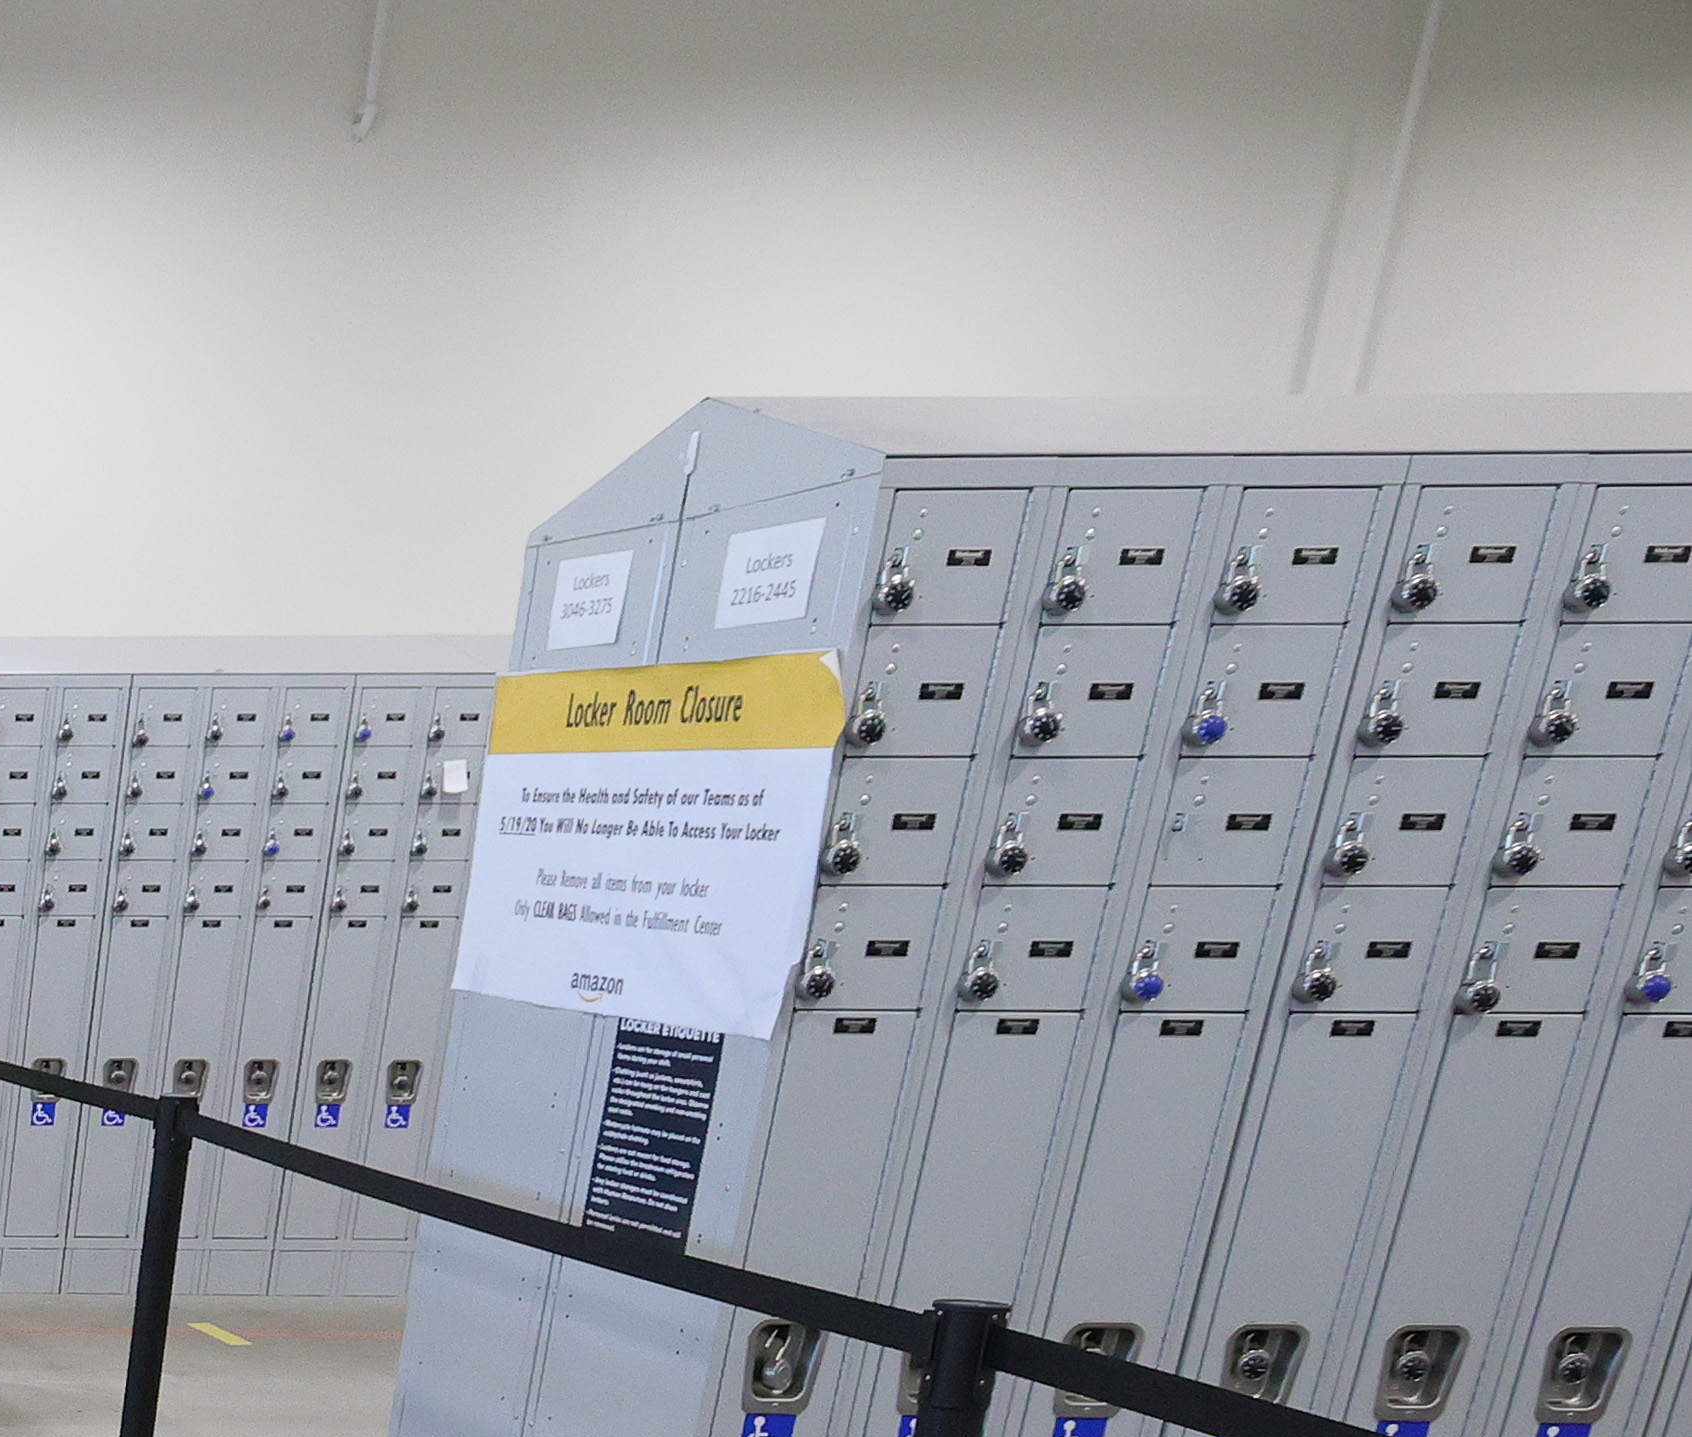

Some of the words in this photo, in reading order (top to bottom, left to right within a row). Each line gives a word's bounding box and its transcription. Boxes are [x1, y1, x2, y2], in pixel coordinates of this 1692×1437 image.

[746, 551, 794, 575] Lockers
[573, 573, 610, 591] Lockers
[730, 580, 797, 607] 2216-2445
[565, 691, 618, 728] Locker
[622, 689, 672, 726] Room
[680, 685, 743, 723] Closure
[522, 788, 531, 803] To
[532, 787, 560, 803] Ensure
[563, 788, 575, 803] the
[578, 788, 609, 804] Health
[612, 788, 631, 804] and
[632, 788, 664, 809] Safety
[666, 788, 679, 805] of
[680, 793, 700, 806] our
[703, 789, 736, 806] Teams
[737, 794, 750, 806] as
[752, 788, 766, 807] of
[498, 816, 537, 834] 5/19/20
[539, 817, 554, 833] You
[556, 818, 574, 833] Will
[575, 818, 589, 834] No
[591, 819, 623, 839] Longer
[626, 820, 639, 836] Be
[641, 820, 665, 837] Able
[668, 821, 678, 837] To
[680, 821, 717, 839] Access
[720, 822, 743, 840] Your
[744, 823, 781, 841] Locker
[655, 882, 678, 900] your
[680, 878, 710, 897] locker
[694, 915, 723, 936] Center
[571, 972, 624, 996] amazon
[621, 1018, 661, 1035] LOCKER
[662, 1023, 720, 1043] ETIQUETTE
